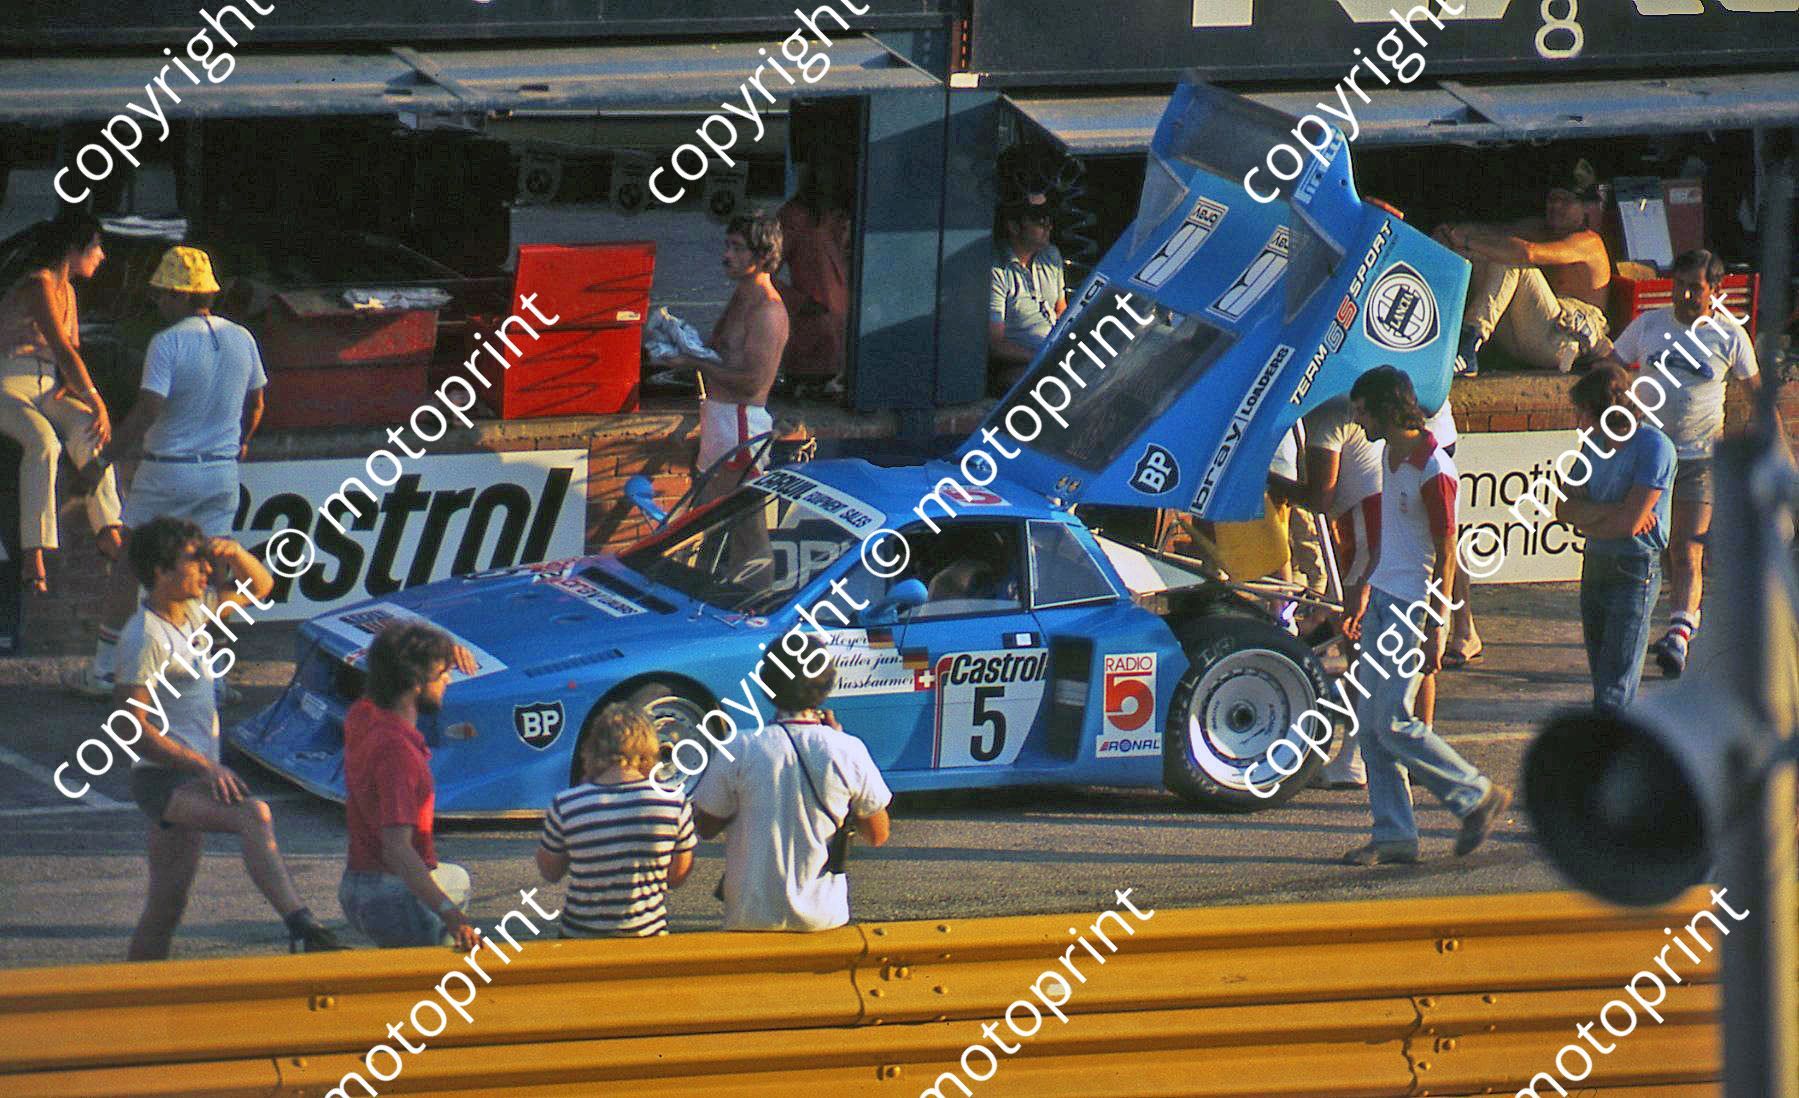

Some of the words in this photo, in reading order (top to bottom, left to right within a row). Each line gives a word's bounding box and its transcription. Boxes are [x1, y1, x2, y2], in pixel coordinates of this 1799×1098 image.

[1534, 0, 1585, 58] 8
[1290, 344, 1328, 406] TEAM
[1349, 219, 1393, 300] SPORT
[1192, 422, 1241, 509] bray
[1240, 347, 1290, 416] LOADERS
[1138, 451, 1173, 492] BP
[232, 467, 574, 603] astrol
[840, 508, 872, 528] SALES
[950, 652, 1048, 685] Castrol
[1105, 656, 1153, 671] RADIO
[521, 710, 560, 738] BP
[969, 686, 1007, 762] 5
[1105, 671, 1155, 731] 5
